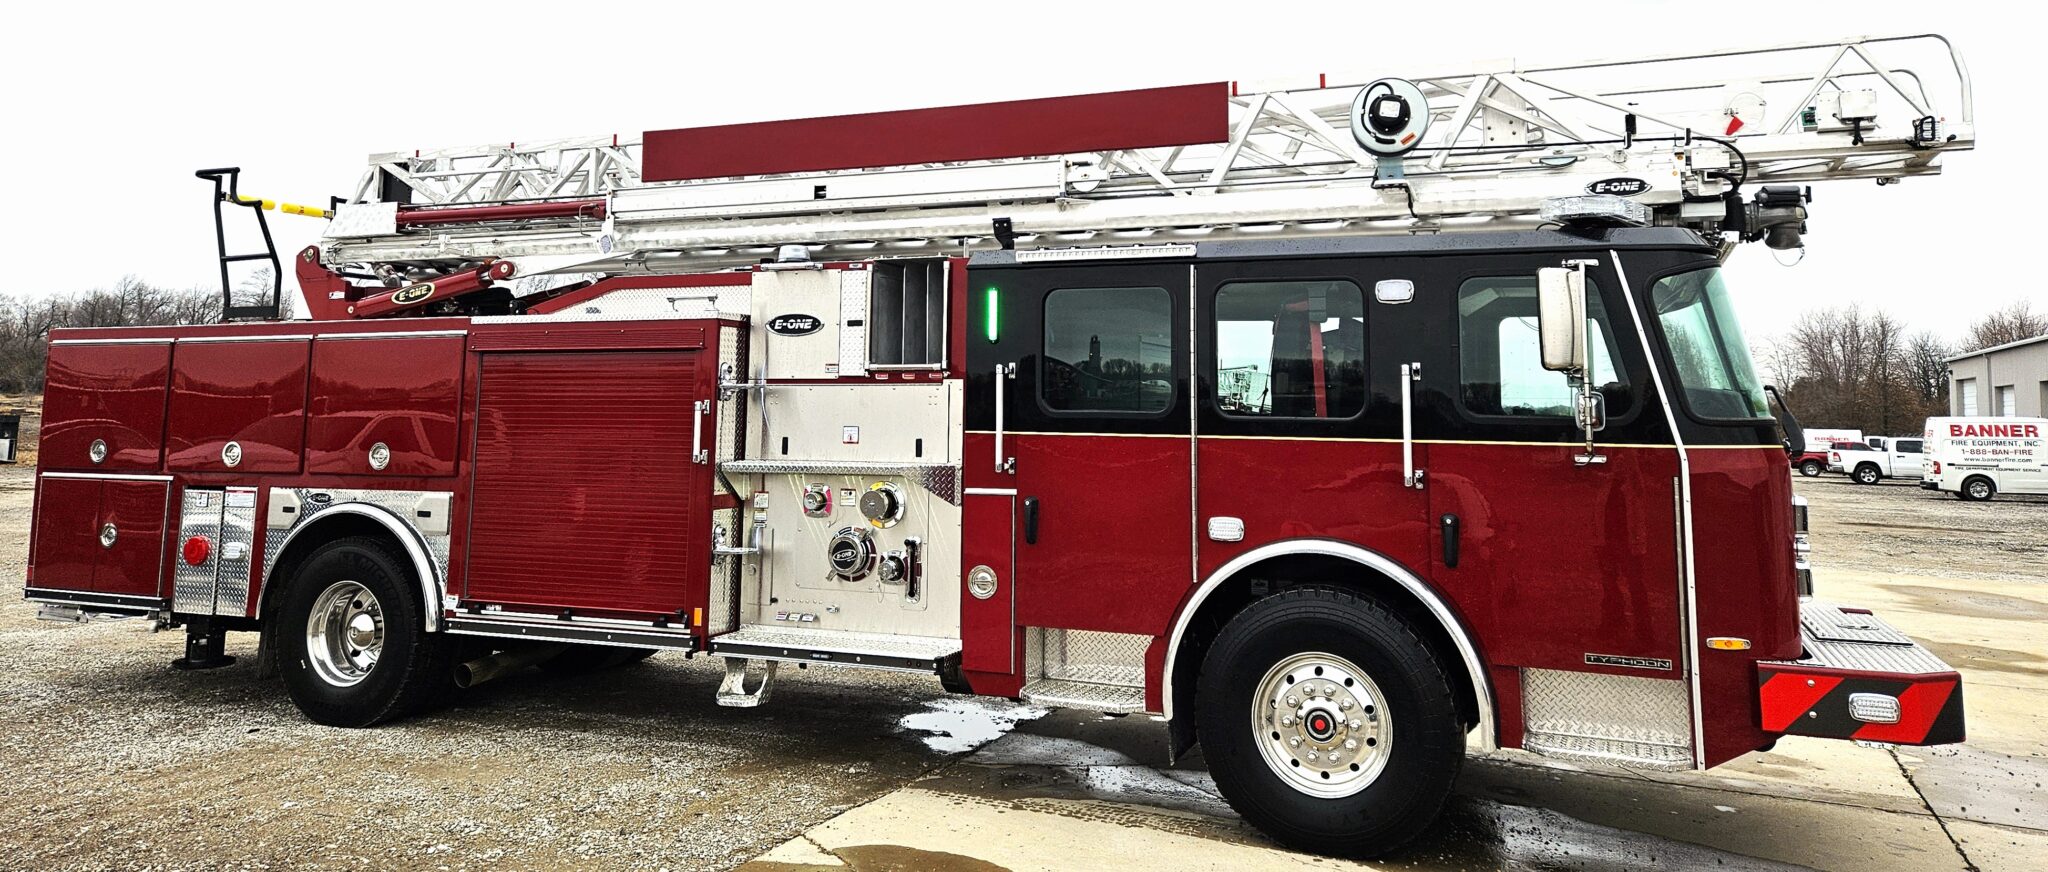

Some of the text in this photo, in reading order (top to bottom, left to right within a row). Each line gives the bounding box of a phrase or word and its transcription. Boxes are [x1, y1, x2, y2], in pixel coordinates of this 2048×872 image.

[1595, 181, 1640, 192] E-ONE
[399, 285, 428, 300] E-ONE
[774, 318, 813, 329] E-ONE
[1950, 424, 2039, 437] BANNER
[1961, 448, 2033, 456] 1-888-BAN-FIRE
[1587, 656, 1669, 667] TYPHOON
